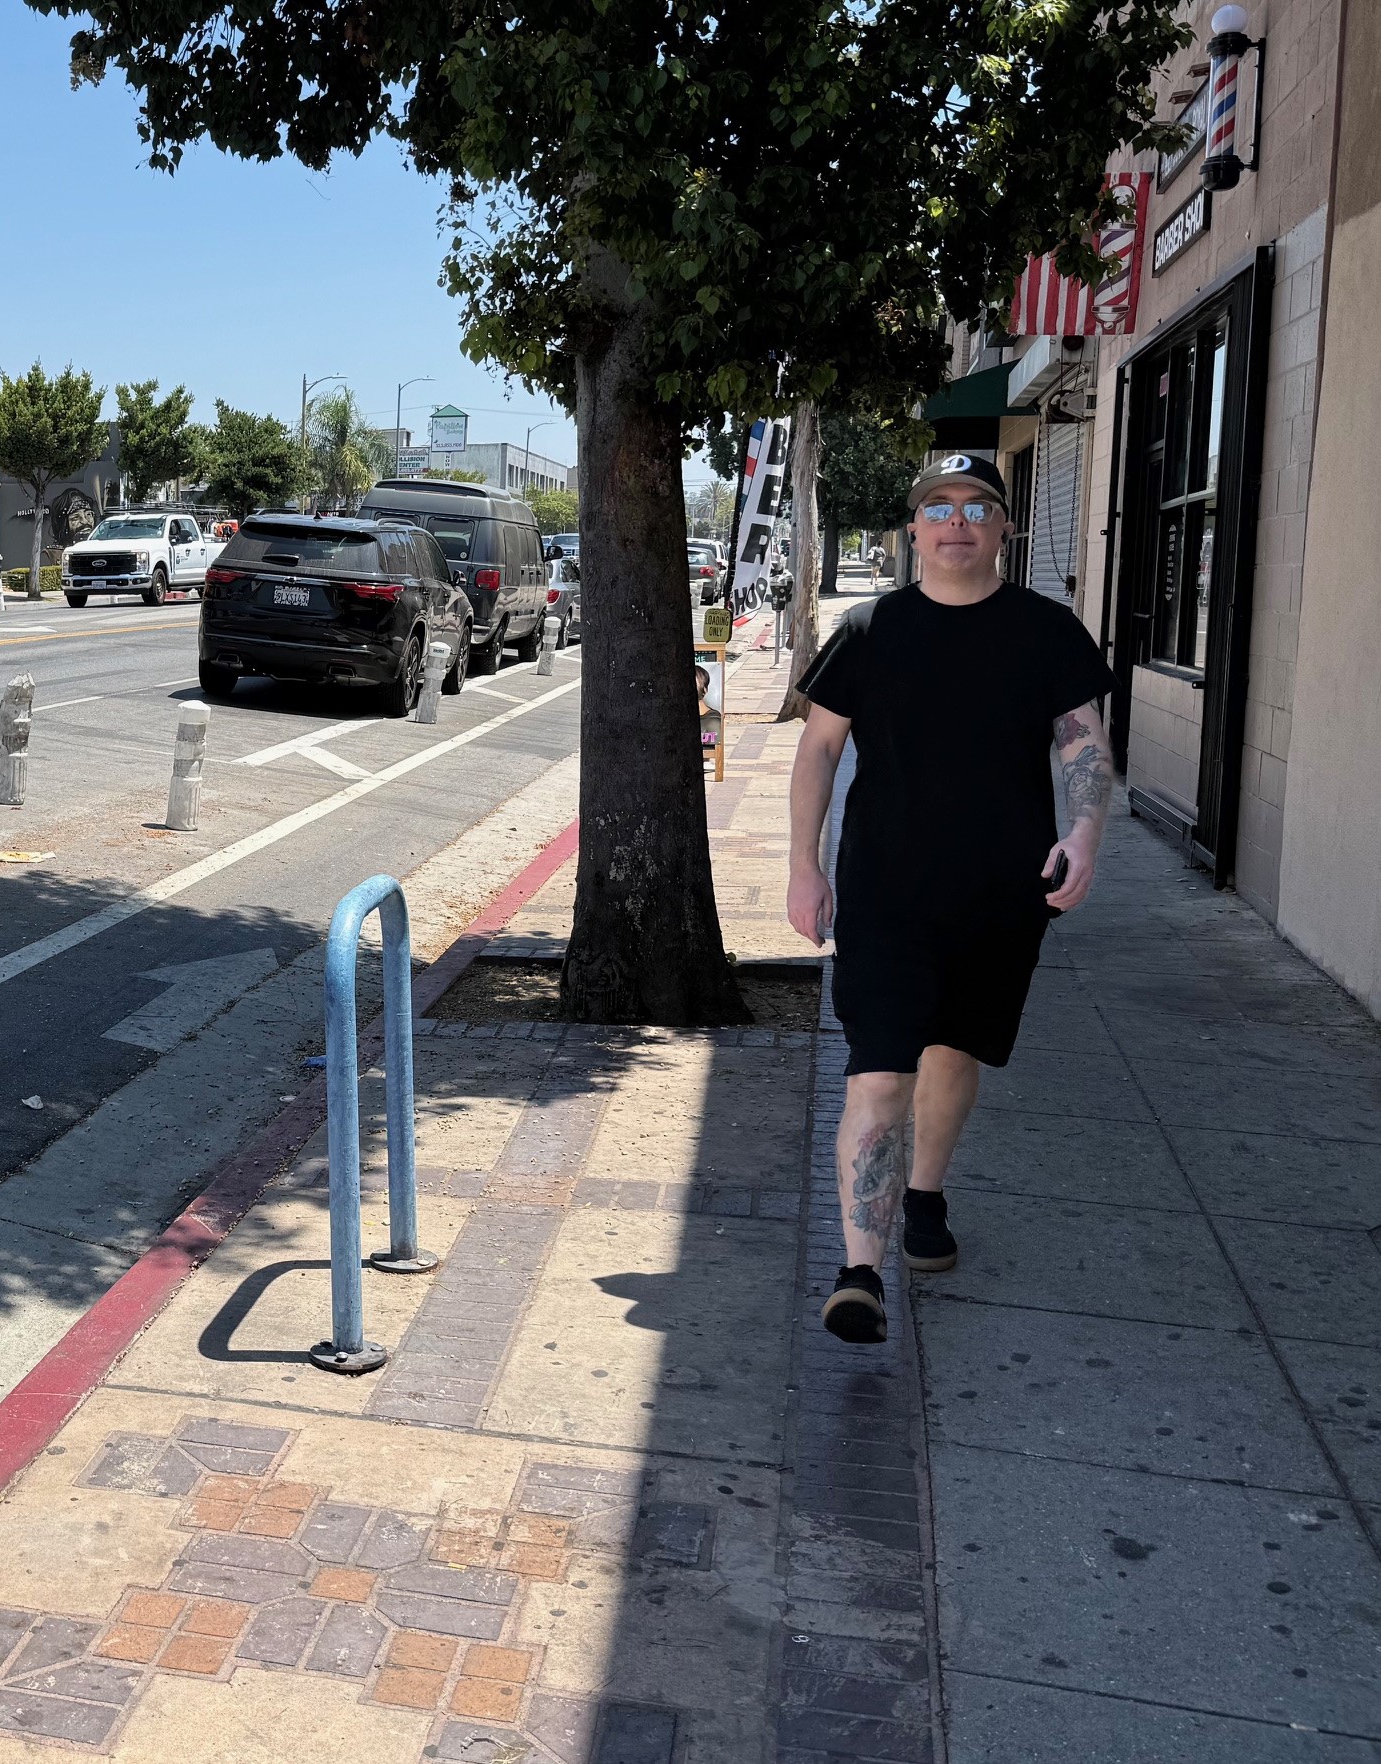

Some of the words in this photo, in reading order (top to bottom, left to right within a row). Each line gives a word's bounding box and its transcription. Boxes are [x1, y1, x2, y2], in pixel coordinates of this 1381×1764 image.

[1155, 213, 1184, 271] BARBER
[940, 454, 972, 475] D
[734, 576, 768, 616] HOP
[705, 616, 729, 626] LOADING
[709, 627, 723, 637] ONLY
